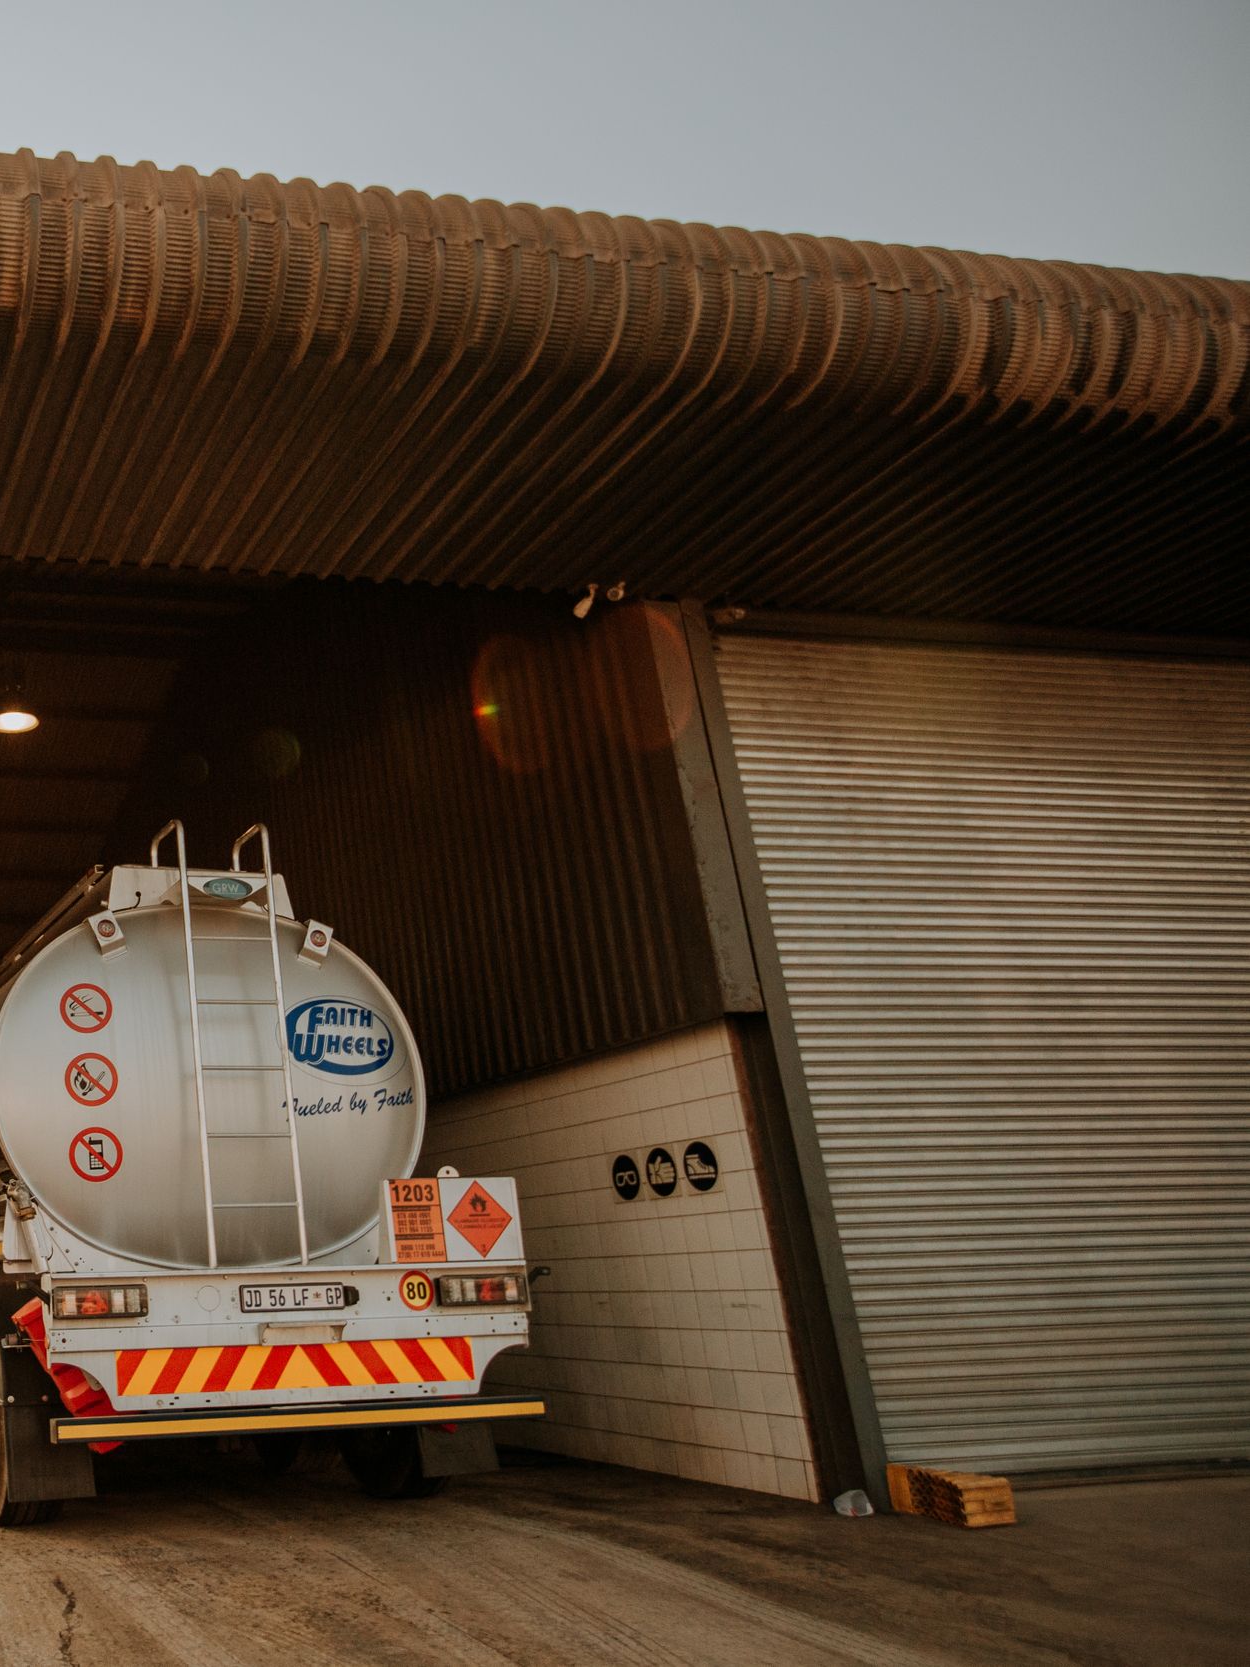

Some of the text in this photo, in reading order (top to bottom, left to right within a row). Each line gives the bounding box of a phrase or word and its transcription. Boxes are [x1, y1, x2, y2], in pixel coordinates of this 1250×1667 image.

[212, 883, 240, 893] GRW
[308, 1006, 373, 1032] FAITH
[293, 1033, 389, 1063] WHEELS
[350, 1092, 367, 1115] by
[373, 1088, 414, 1111] Faith
[392, 1184, 434, 1202] 1203
[245, 1287, 342, 1307] JD 56 LF GP
[406, 1281, 427, 1300] 80
